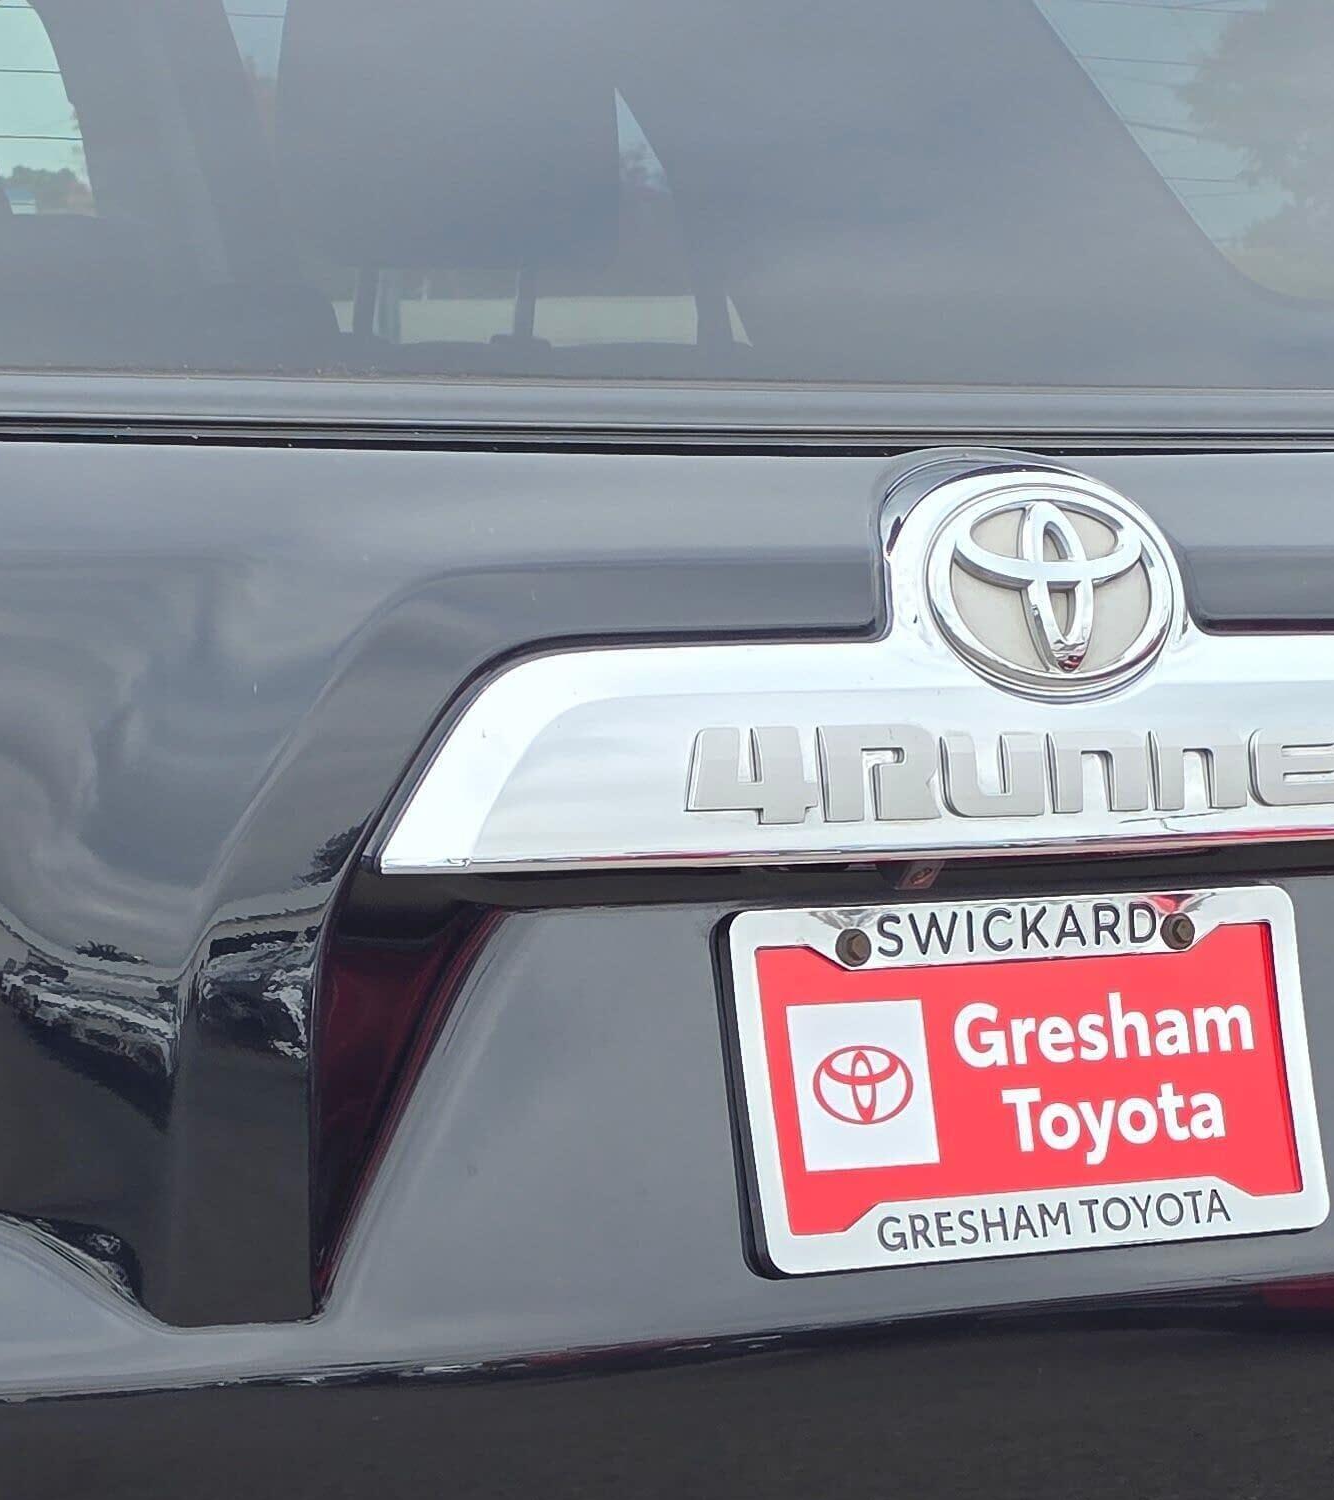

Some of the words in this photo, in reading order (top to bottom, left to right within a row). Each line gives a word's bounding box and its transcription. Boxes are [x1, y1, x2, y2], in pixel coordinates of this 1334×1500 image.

[877, 902, 1157, 957] SWICKARD
[953, 991, 1255, 1068] Gresham
[1001, 1082, 1227, 1166] Toyota
[876, 1201, 1072, 1252] GRESHAM
[1078, 1188, 1232, 1233] TOYOTA
